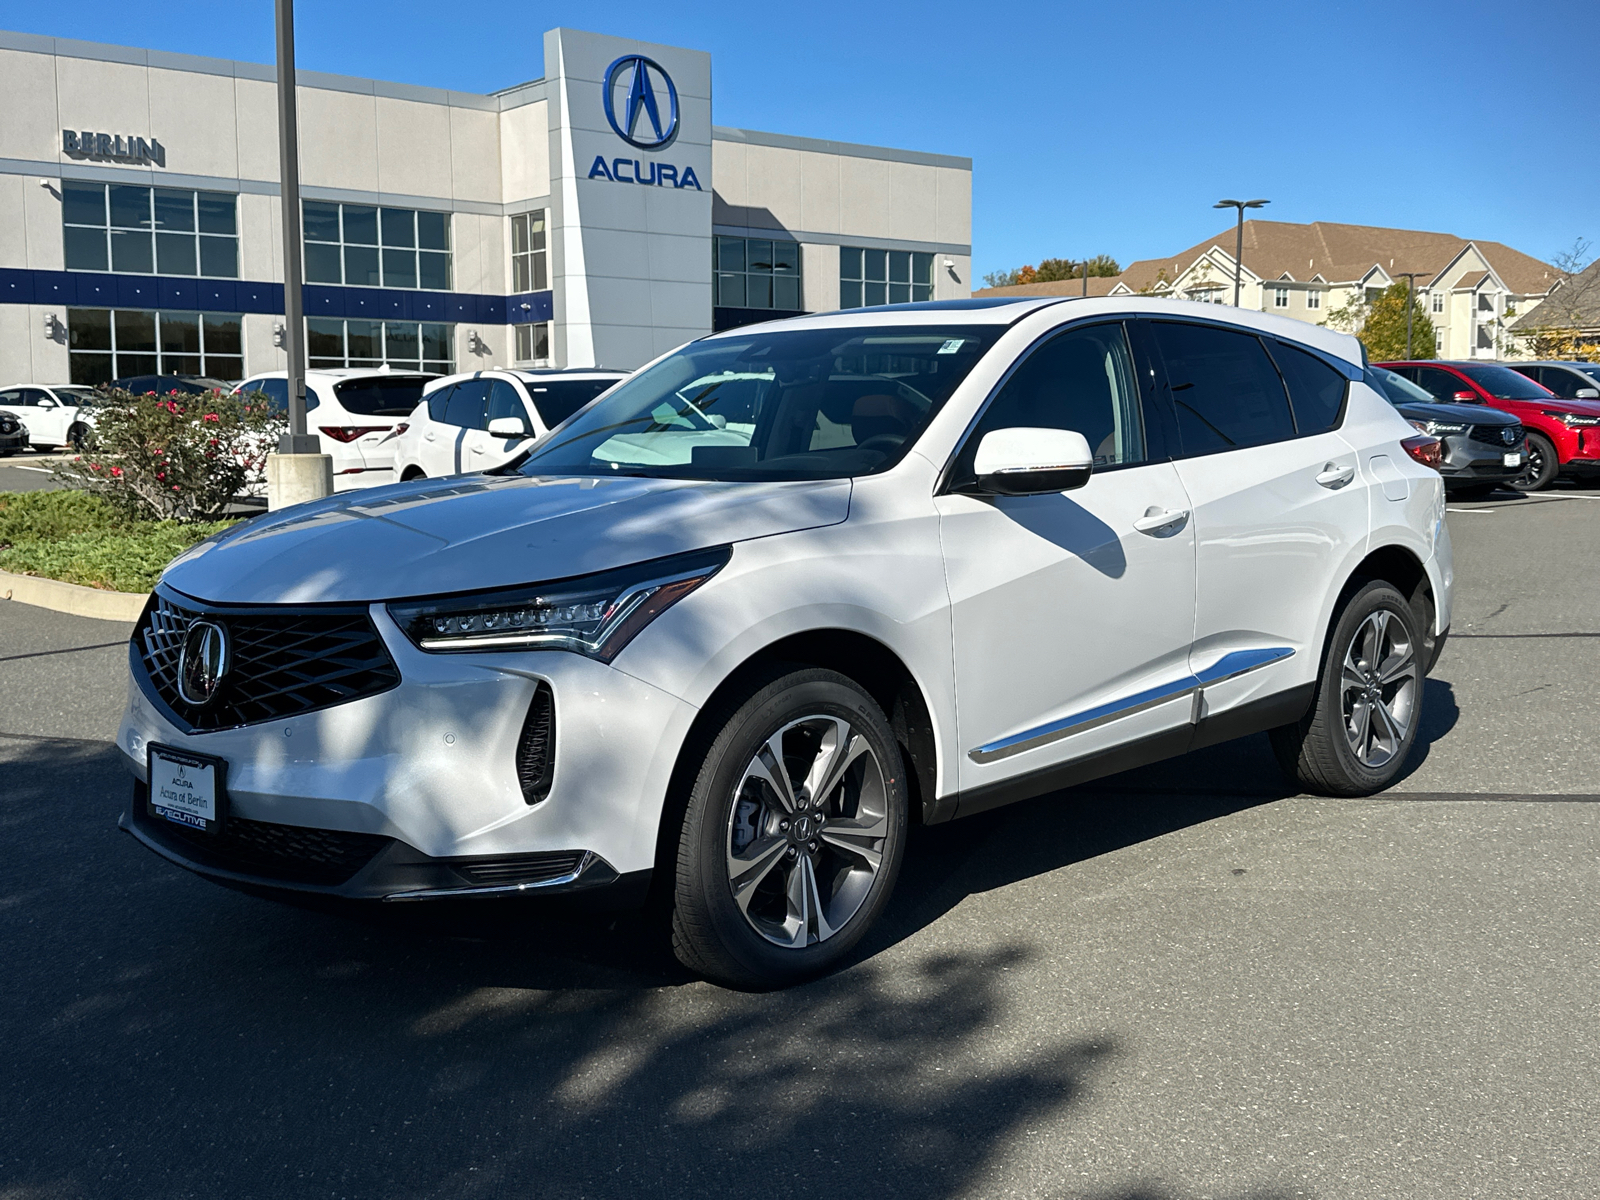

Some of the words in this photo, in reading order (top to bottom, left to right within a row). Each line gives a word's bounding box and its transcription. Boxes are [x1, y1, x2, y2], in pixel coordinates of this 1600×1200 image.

[62, 129, 159, 161] BERLIN
[588, 155, 703, 191] ACURA
[171, 778, 193, 789] ACURA
[160, 786, 177, 801] Acura
[178, 792, 186, 804] of
[187, 792, 208, 809] Berlin
[155, 806, 206, 828] EXECUTIVE
